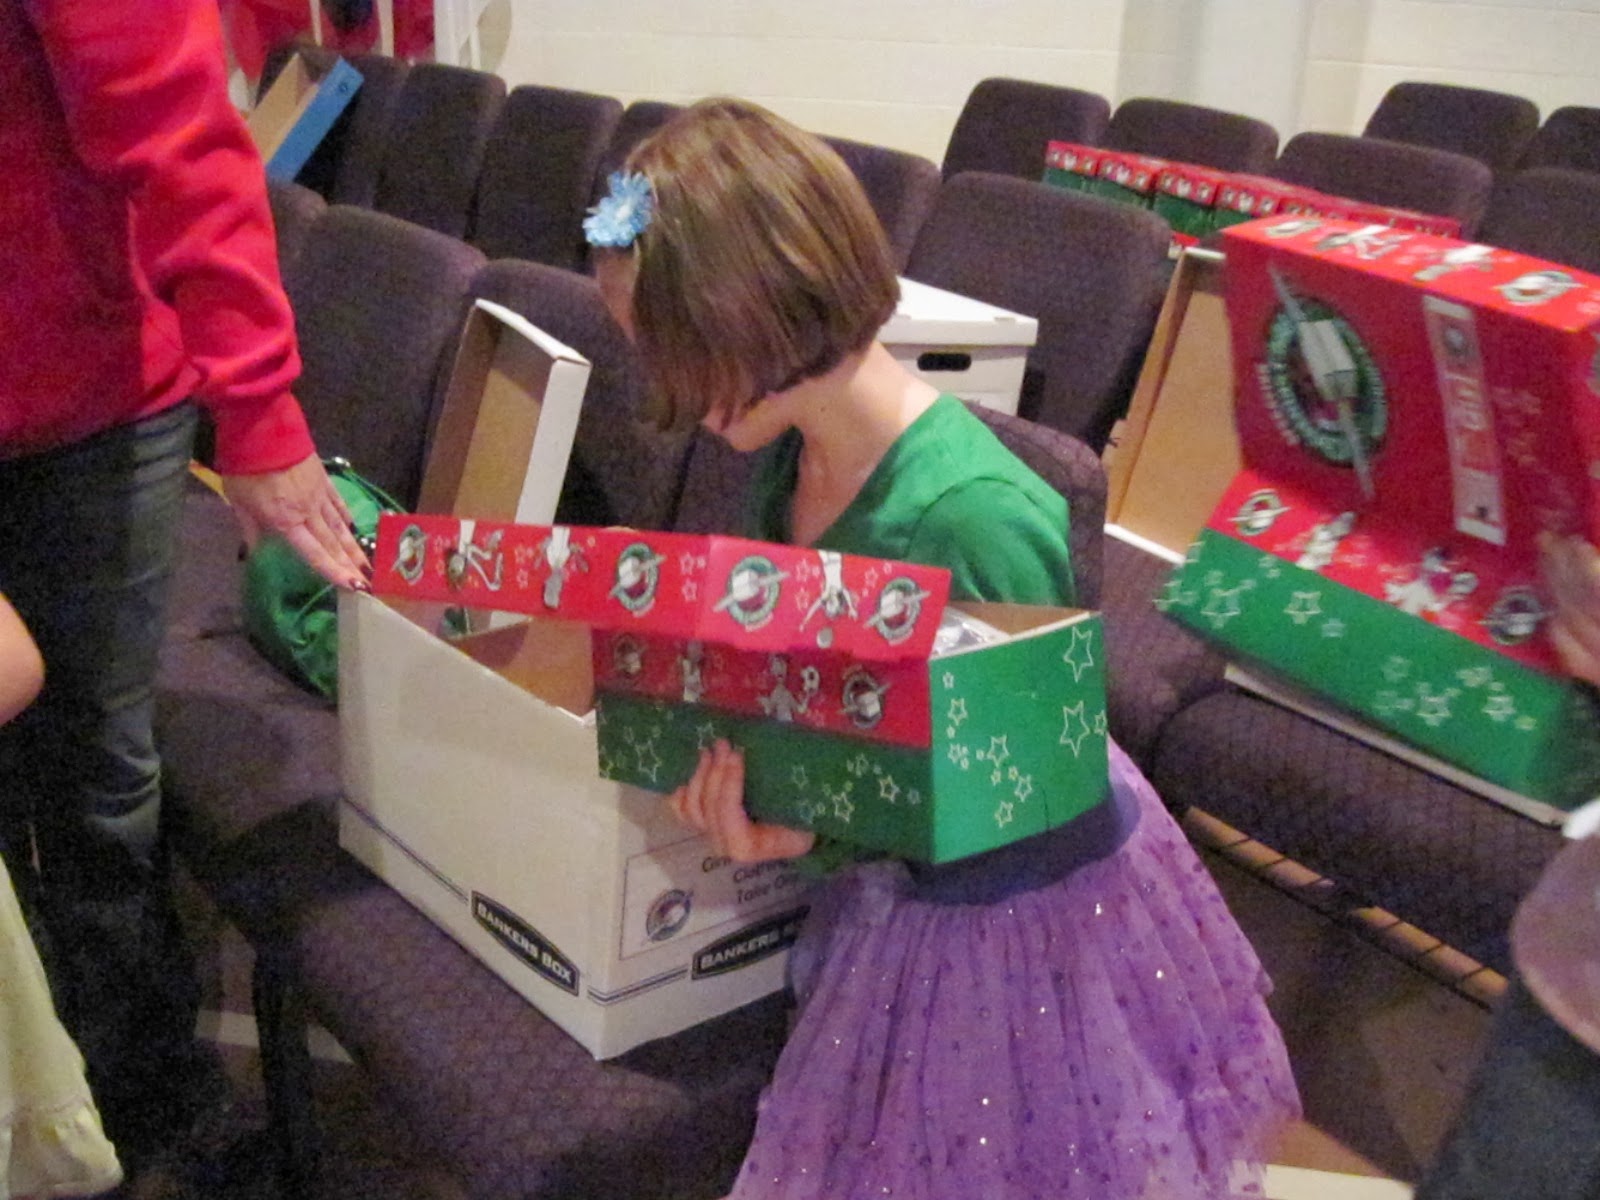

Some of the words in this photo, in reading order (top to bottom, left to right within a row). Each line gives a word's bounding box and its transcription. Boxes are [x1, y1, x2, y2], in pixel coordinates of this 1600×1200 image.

[477, 901, 539, 959] BANKERS
[541, 951, 573, 984] BOX
[700, 929, 781, 970] BANKERS
